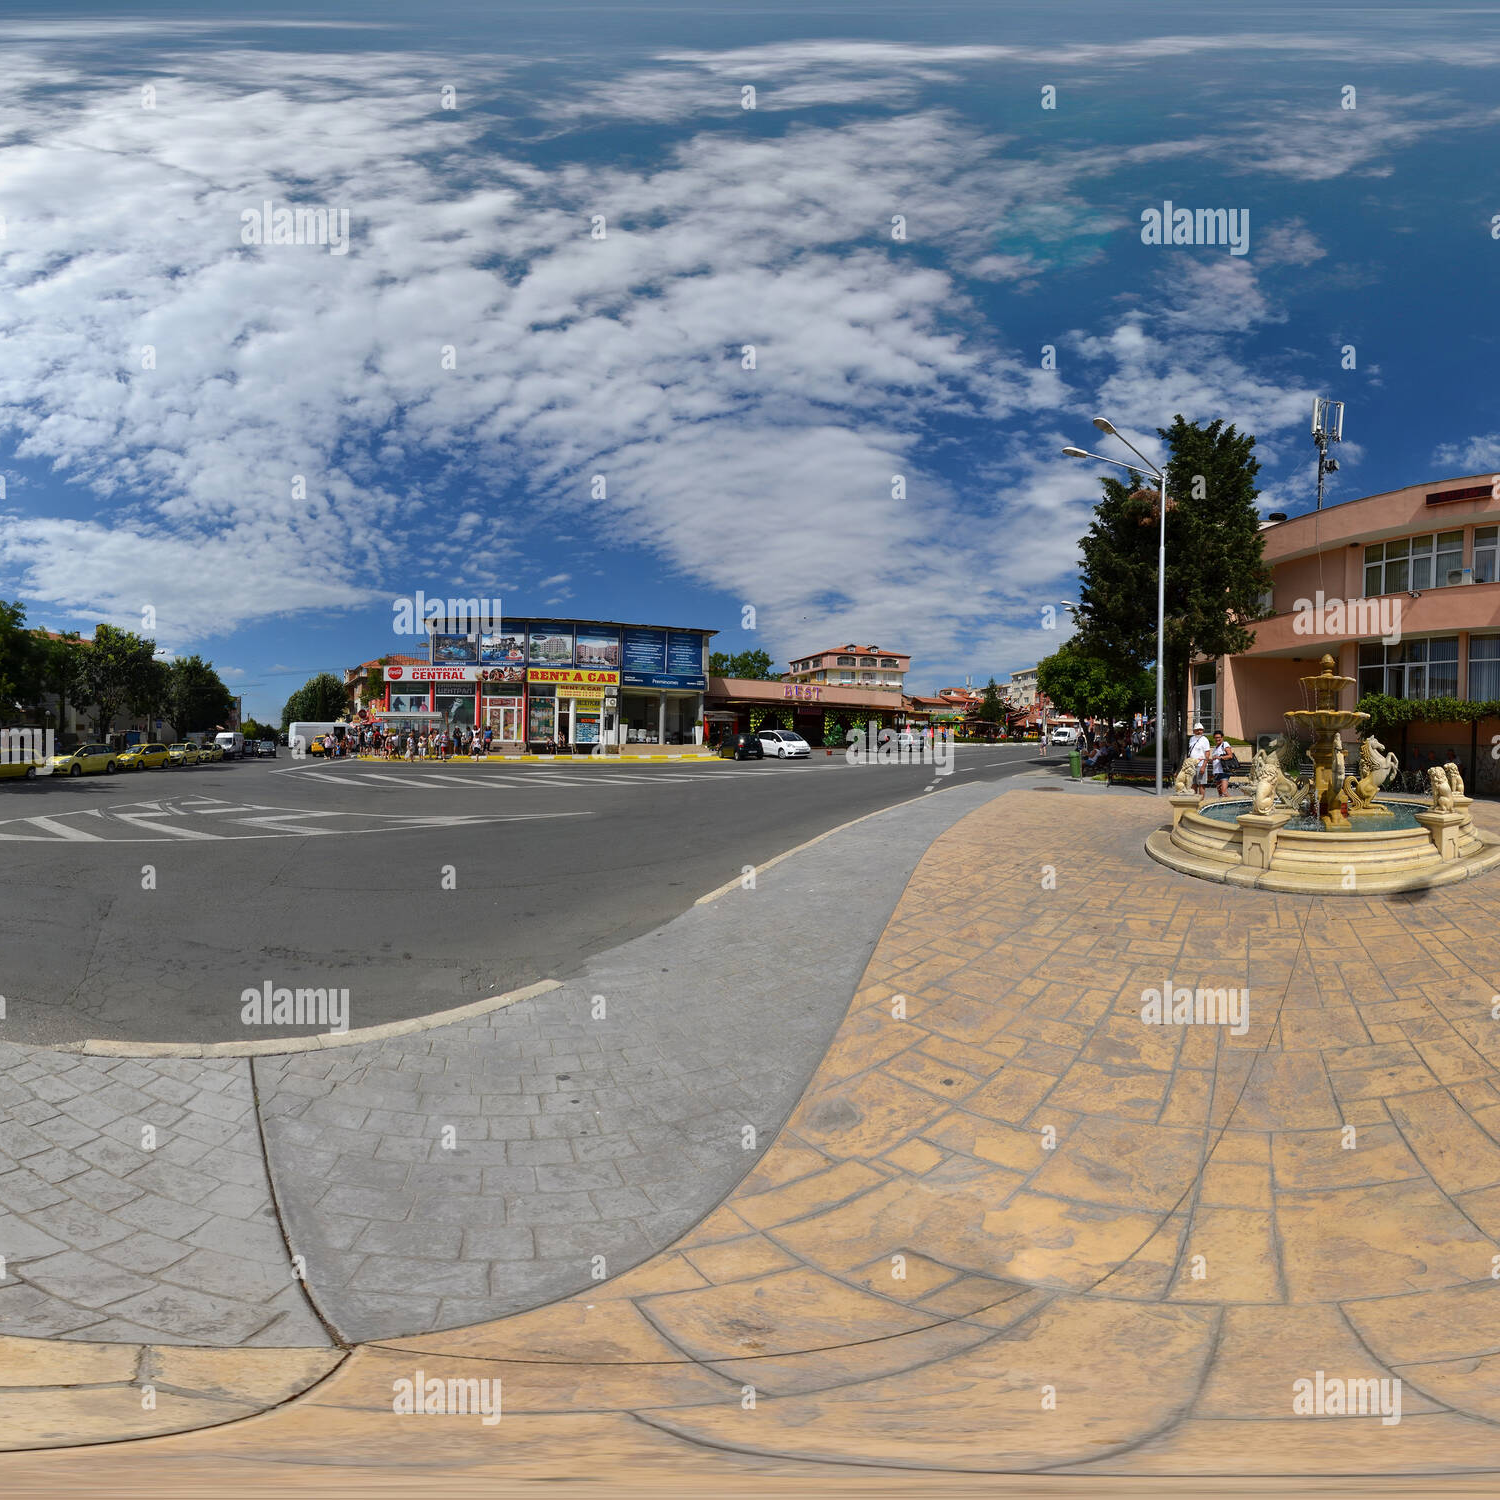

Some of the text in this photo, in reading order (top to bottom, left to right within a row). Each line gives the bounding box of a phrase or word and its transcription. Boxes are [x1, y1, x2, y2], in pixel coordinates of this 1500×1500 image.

[412, 671, 466, 680] CENTRAL
[529, 670, 570, 681] RENT
[573, 672, 584, 681] A
[587, 672, 617, 682] CAR
[784, 684, 822, 701] BEST
